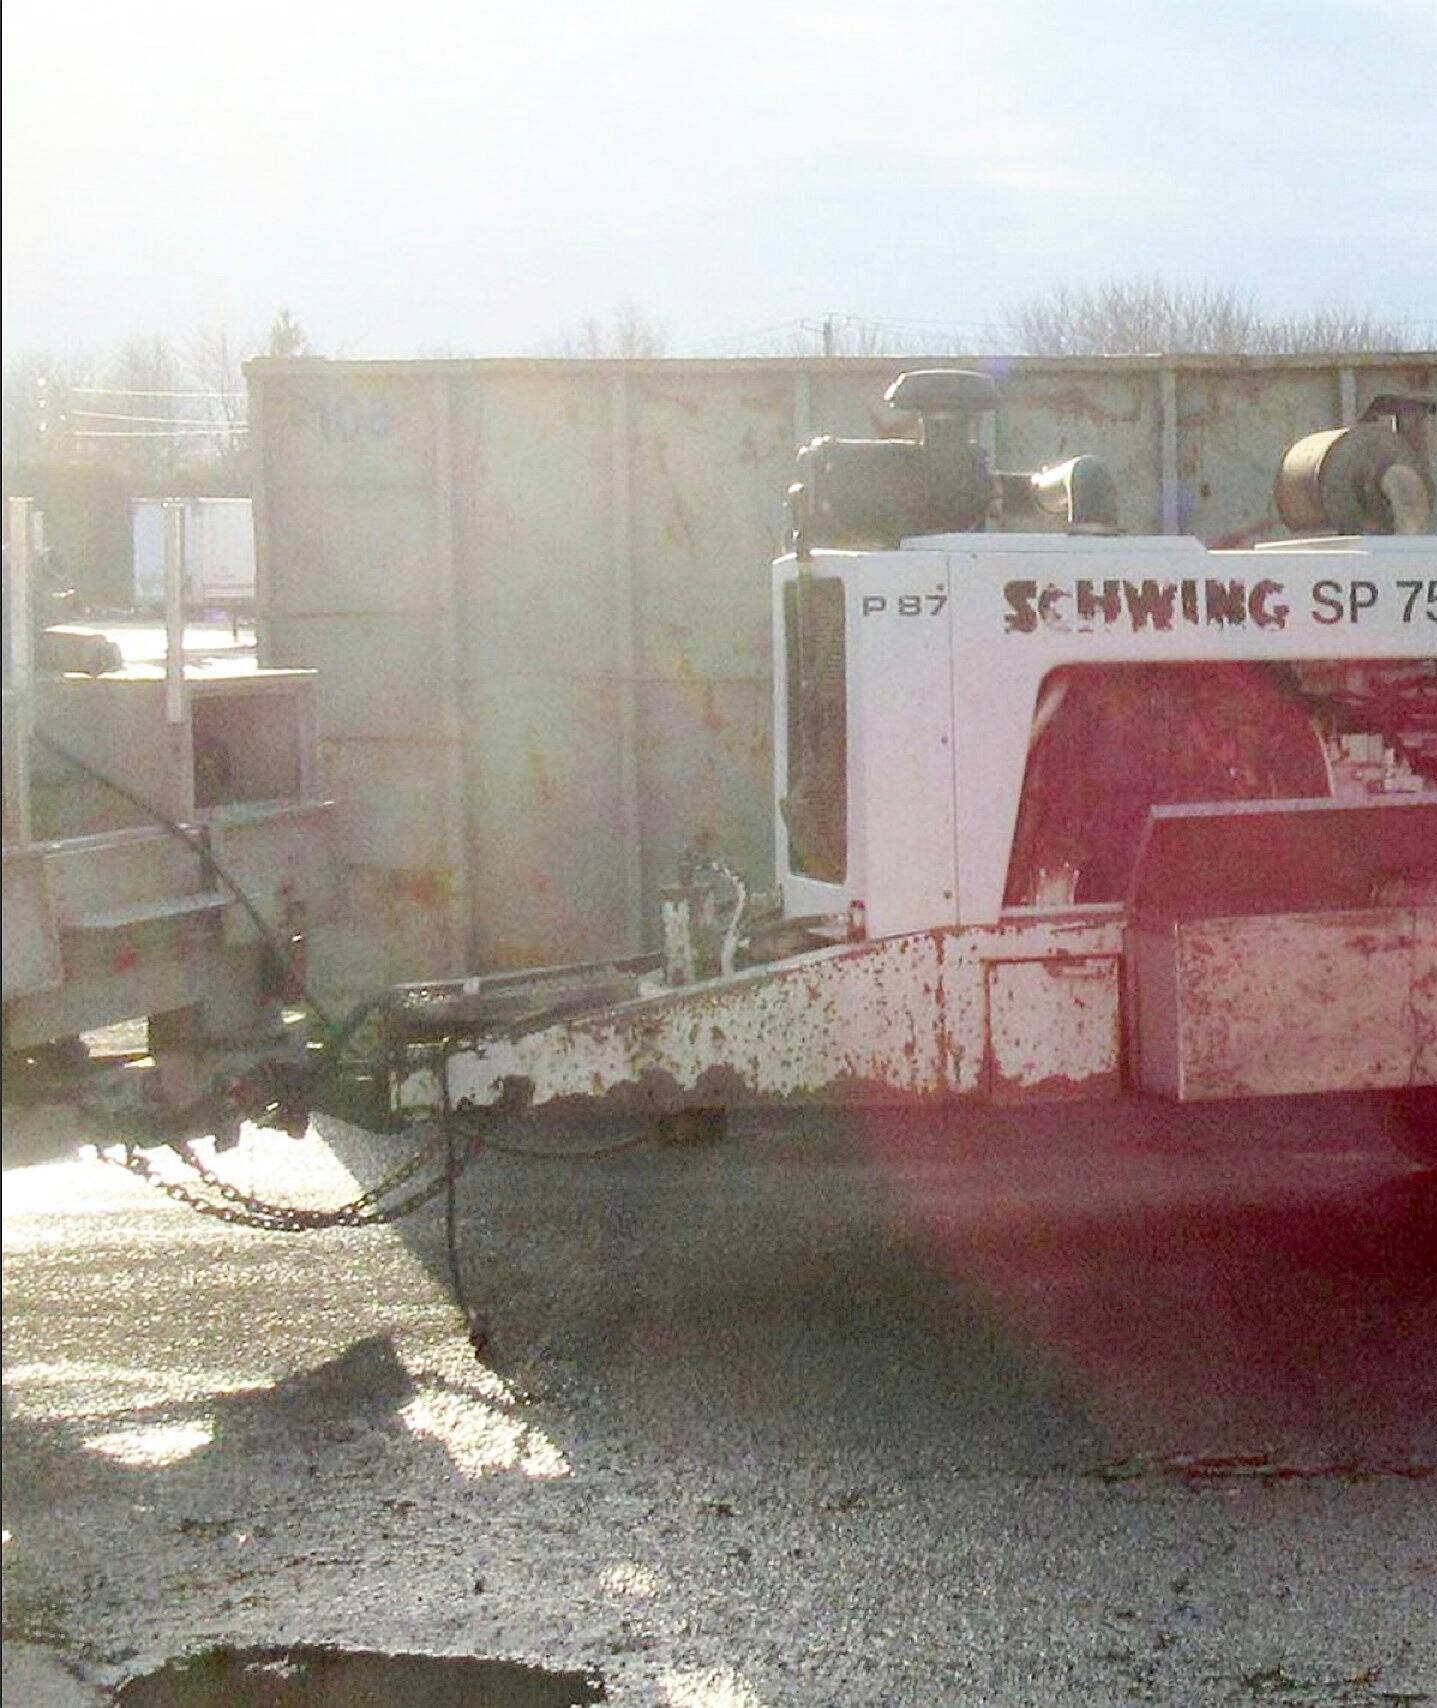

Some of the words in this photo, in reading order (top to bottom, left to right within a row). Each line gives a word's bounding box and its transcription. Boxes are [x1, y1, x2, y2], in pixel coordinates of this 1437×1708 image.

[862, 595, 887, 617] P
[897, 594, 949, 617] 87
[1003, 579, 1290, 634] SCHWING
[1311, 579, 1379, 625] SP
